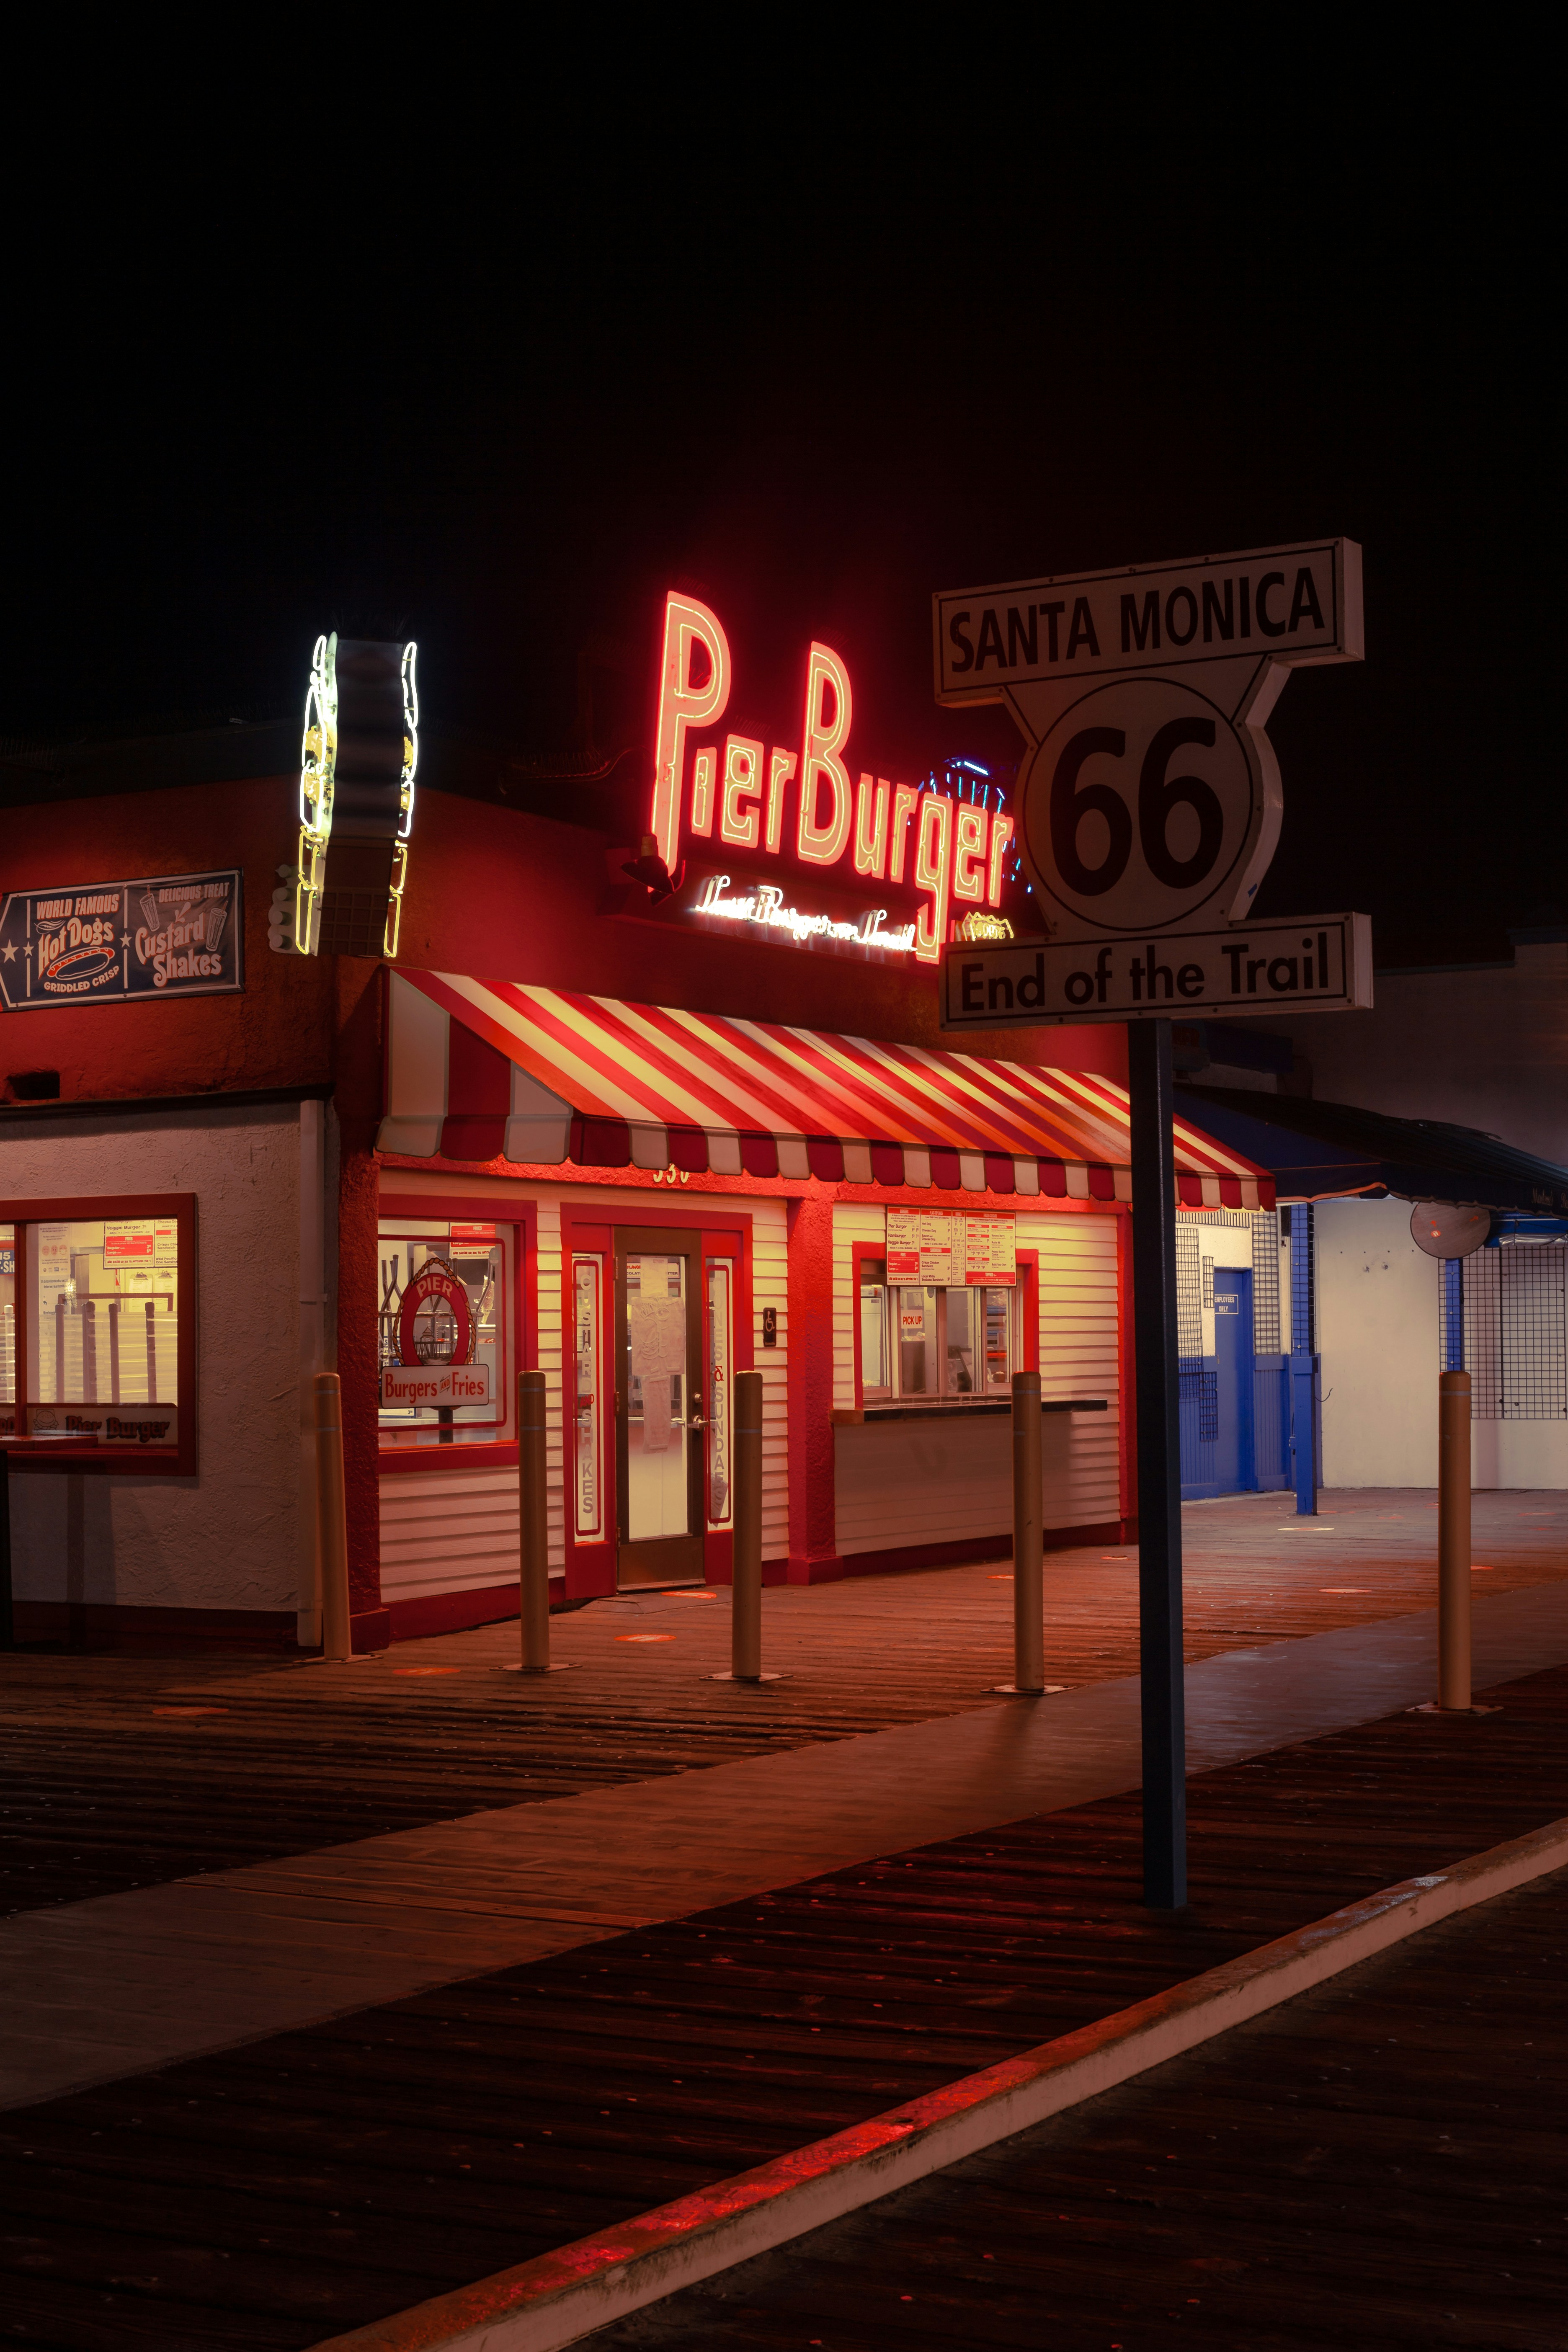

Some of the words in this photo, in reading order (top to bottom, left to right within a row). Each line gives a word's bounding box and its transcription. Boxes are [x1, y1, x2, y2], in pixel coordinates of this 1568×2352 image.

[950, 596, 1100, 673] SANTA
[1120, 567, 1325, 654] MONICA
[648, 591, 798, 892] Pier
[797, 641, 1014, 965] Burger
[1050, 716, 1224, 897] 66
[37, 899, 73, 920] WORLD
[75, 894, 120, 915] FAMOUS
[158, 886, 201, 903] DELICIOUS
[204, 882, 230, 897] TREAT
[38, 926, 67, 980] Hot
[67, 917, 115, 948] Dogs
[134, 911, 205, 965] Custard
[43, 981, 90, 993] GRIDDLED
[92, 965, 120, 988] CRISP
[152, 951, 223, 988] Shakes
[961, 952, 1045, 1012] End
[1064, 946, 1113, 1006] of
[1130, 944, 1205, 1002] the
[1221, 932, 1329, 995] Trail
[416, 1276, 453, 1298] PIER
[580, 1274, 593, 1394] CUSTARD
[903, 1316, 915, 1325] PICK
[915, 1316, 922, 1325] UP
[385, 1373, 438, 1404] Burgers
[441, 1379, 450, 1390] AND
[452, 1372, 485, 1396] Fries
[714, 1366, 724, 1382] &
[580, 1393, 594, 1408] AND
[65, 1415, 102, 1436] Pier
[106, 1417, 170, 1443] Burger
[580, 1409, 594, 1514] SHAKES
